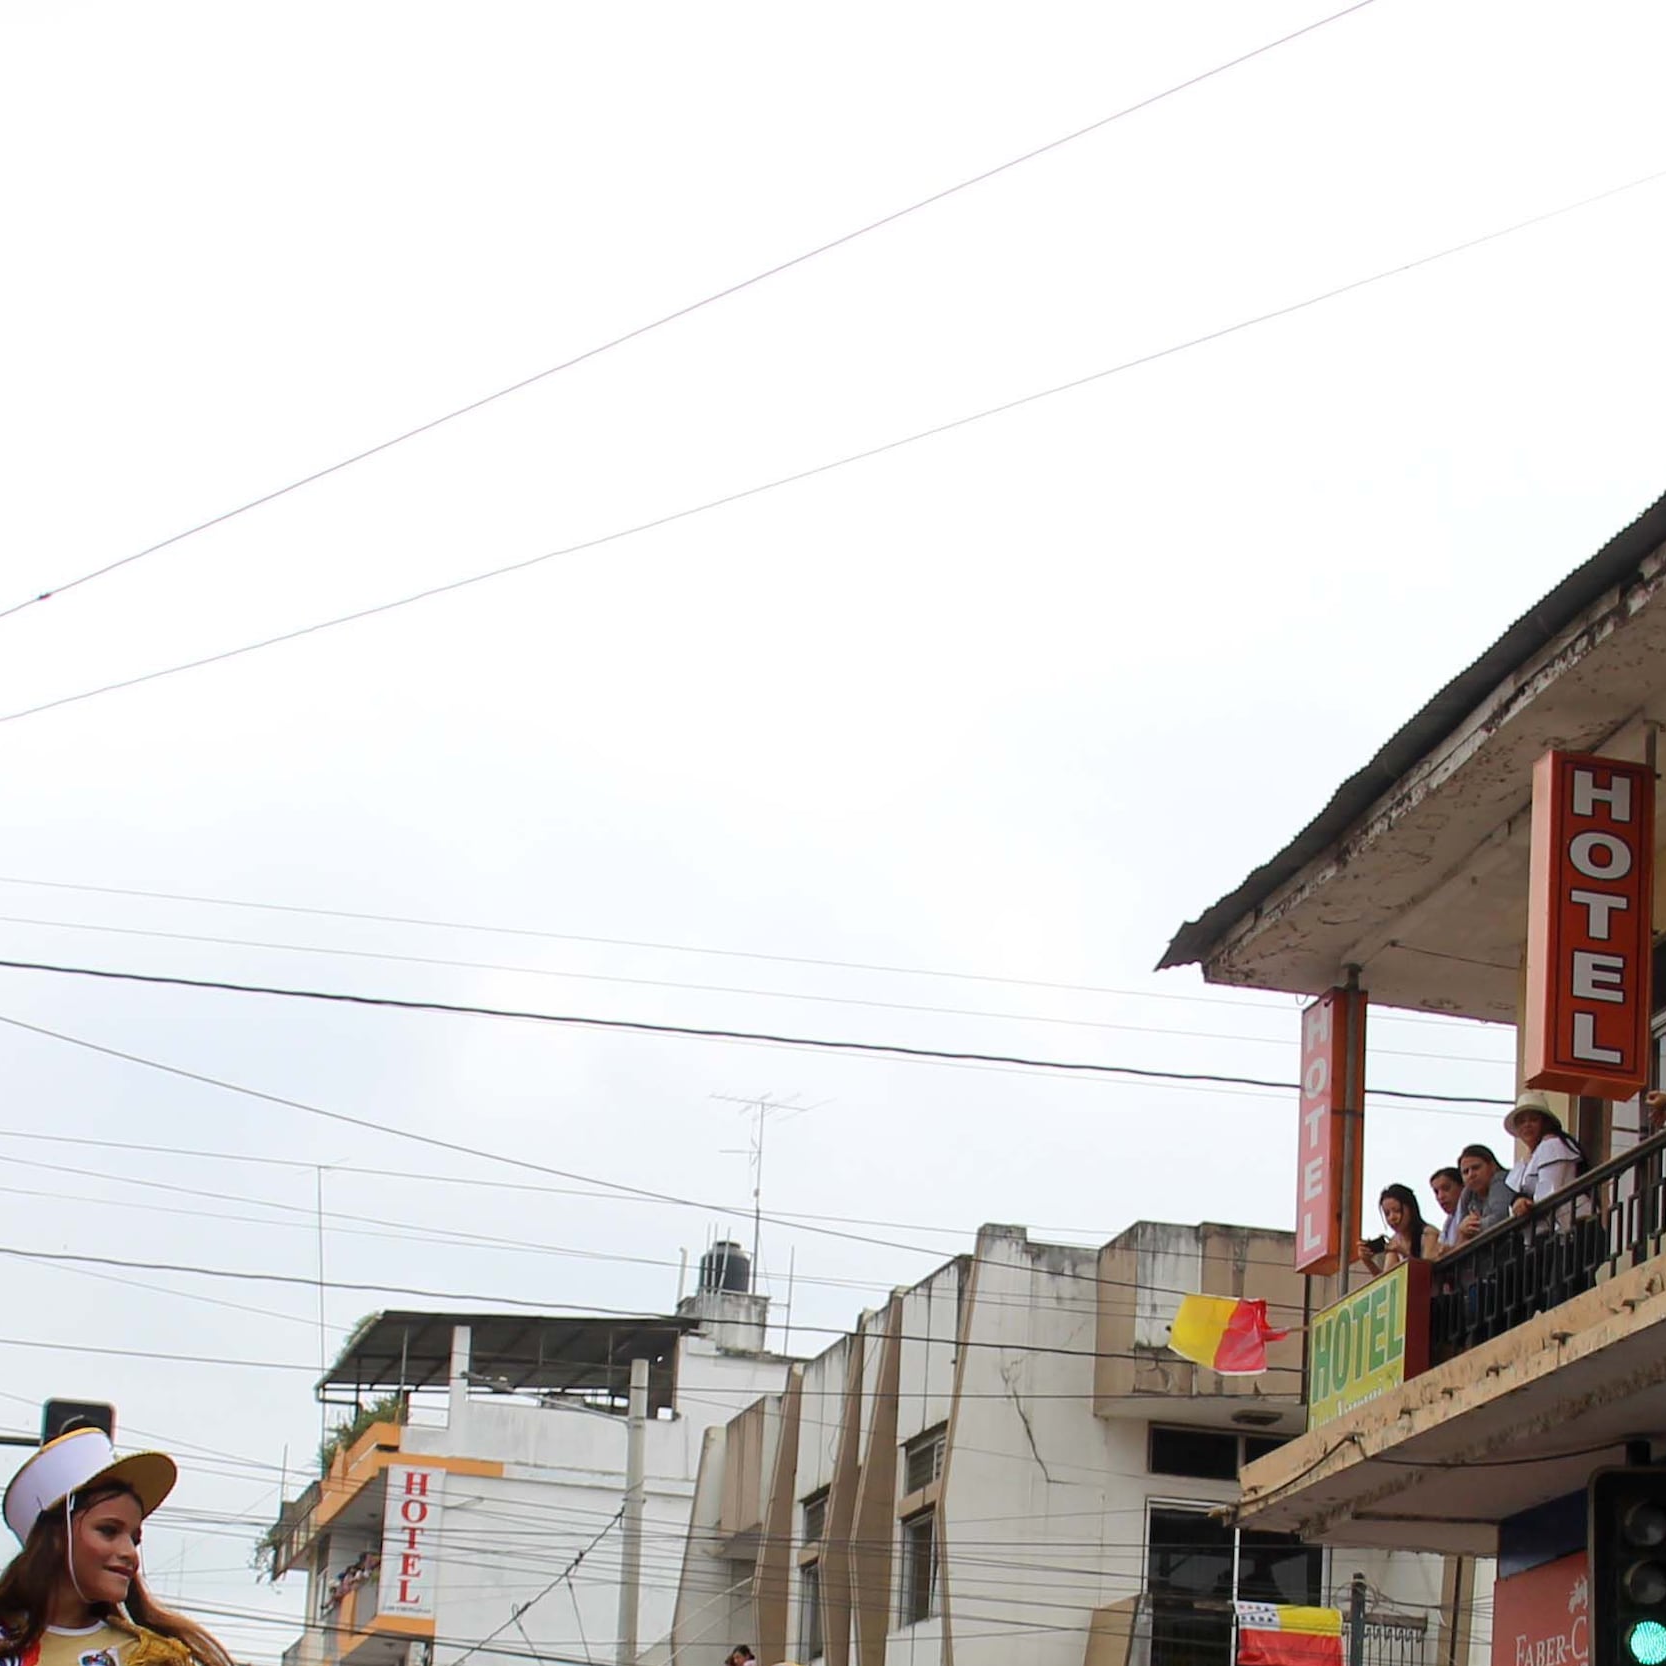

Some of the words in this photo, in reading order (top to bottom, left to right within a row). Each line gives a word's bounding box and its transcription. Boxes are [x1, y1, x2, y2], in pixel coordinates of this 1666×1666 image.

[1569, 769, 1632, 1064] HOTEL
[1303, 1001, 1329, 1252] HOTEL
[1312, 1275, 1404, 1407] HOTEL
[398, 1471, 431, 1604] HOTEL
